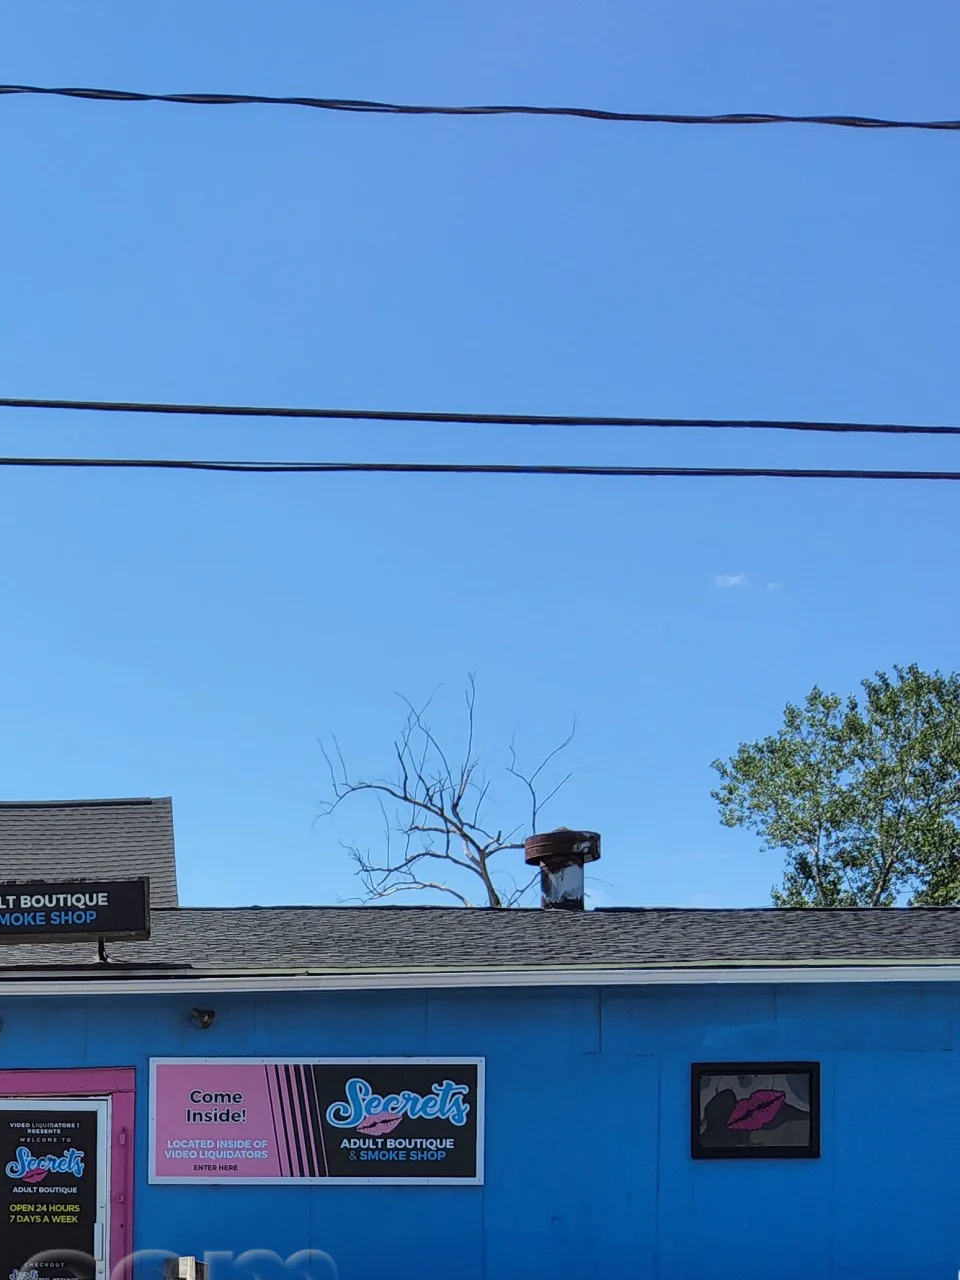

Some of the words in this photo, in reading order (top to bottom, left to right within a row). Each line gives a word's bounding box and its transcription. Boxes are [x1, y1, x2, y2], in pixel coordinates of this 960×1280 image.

[20, 893, 109, 908] BOUTIQUE
[51, 910, 97, 925] SHOP
[190, 1090, 243, 1104] Come
[326, 1078, 469, 1127] Secrets
[186, 1107, 247, 1123] Inside!
[167, 1140, 215, 1148] LOCATED
[216, 1140, 252, 1148] INSIDE
[253, 1140, 268, 1148] OF
[340, 1138, 385, 1149] ADULT
[386, 1138, 455, 1151] BOUTIQUE
[164, 1150, 198, 1159] VIDEO
[199, 1150, 269, 1160] LIQUIDATORS
[348, 1151, 358, 1161] &
[359, 1151, 407, 1161] SMOKE
[410, 1151, 446, 1161] SHOP
[5, 1146, 85, 1179] Secrets
[12, 1186, 38, 1194] ADULT
[38, 1186, 78, 1195] BOUTIQUE
[9, 1203, 35, 1213] OPEN
[36, 1203, 47, 1213] 24
[48, 1204, 81, 1213] HOURS
[9, 1214, 16, 1223] 7
[16, 1214, 41, 1223] DAYS
[42, 1215, 50, 1223] A
[52, 1215, 79, 1223] WEEK
